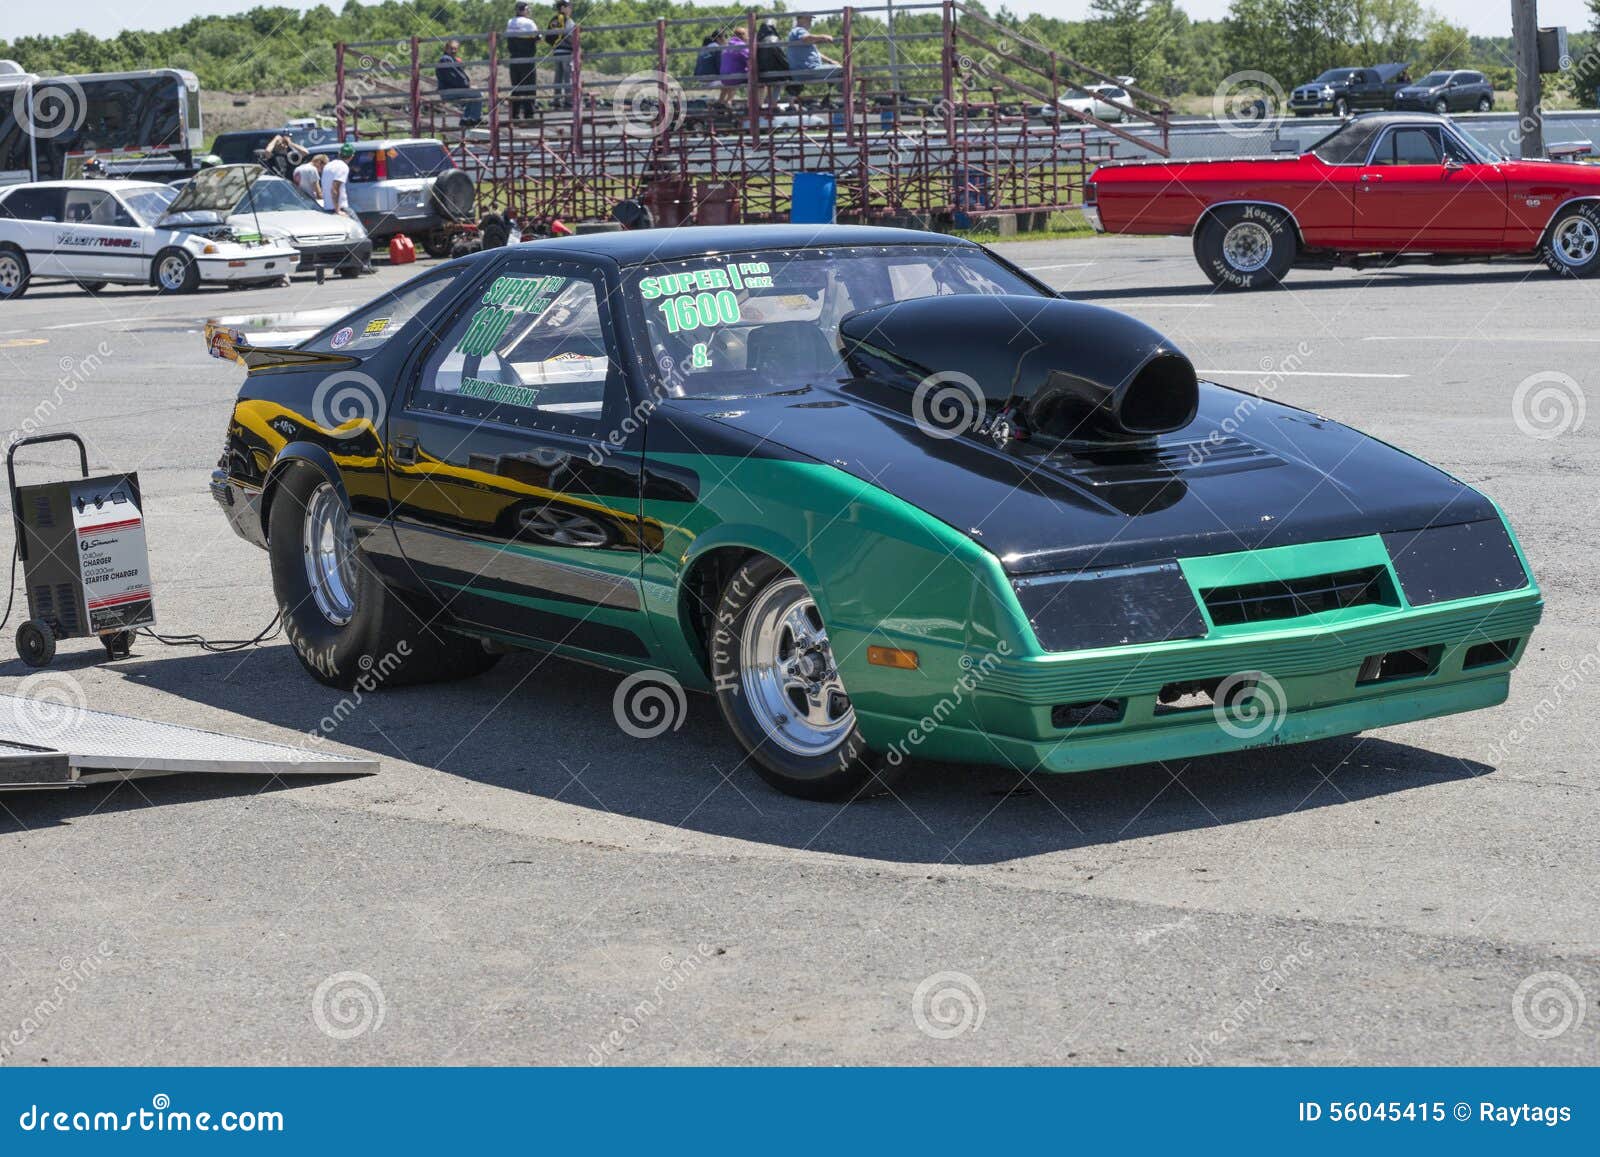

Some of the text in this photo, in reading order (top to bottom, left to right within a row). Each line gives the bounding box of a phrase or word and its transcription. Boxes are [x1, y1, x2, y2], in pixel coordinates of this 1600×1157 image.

[639, 268, 731, 299] SUPER
[739, 261, 770, 275] PRO
[482, 276, 539, 306] SUPER
[658, 289, 741, 334] 1600
[455, 305, 516, 358] 1600
[83, 556, 112, 568] CHARGER
[714, 566, 757, 697] Hoosier
